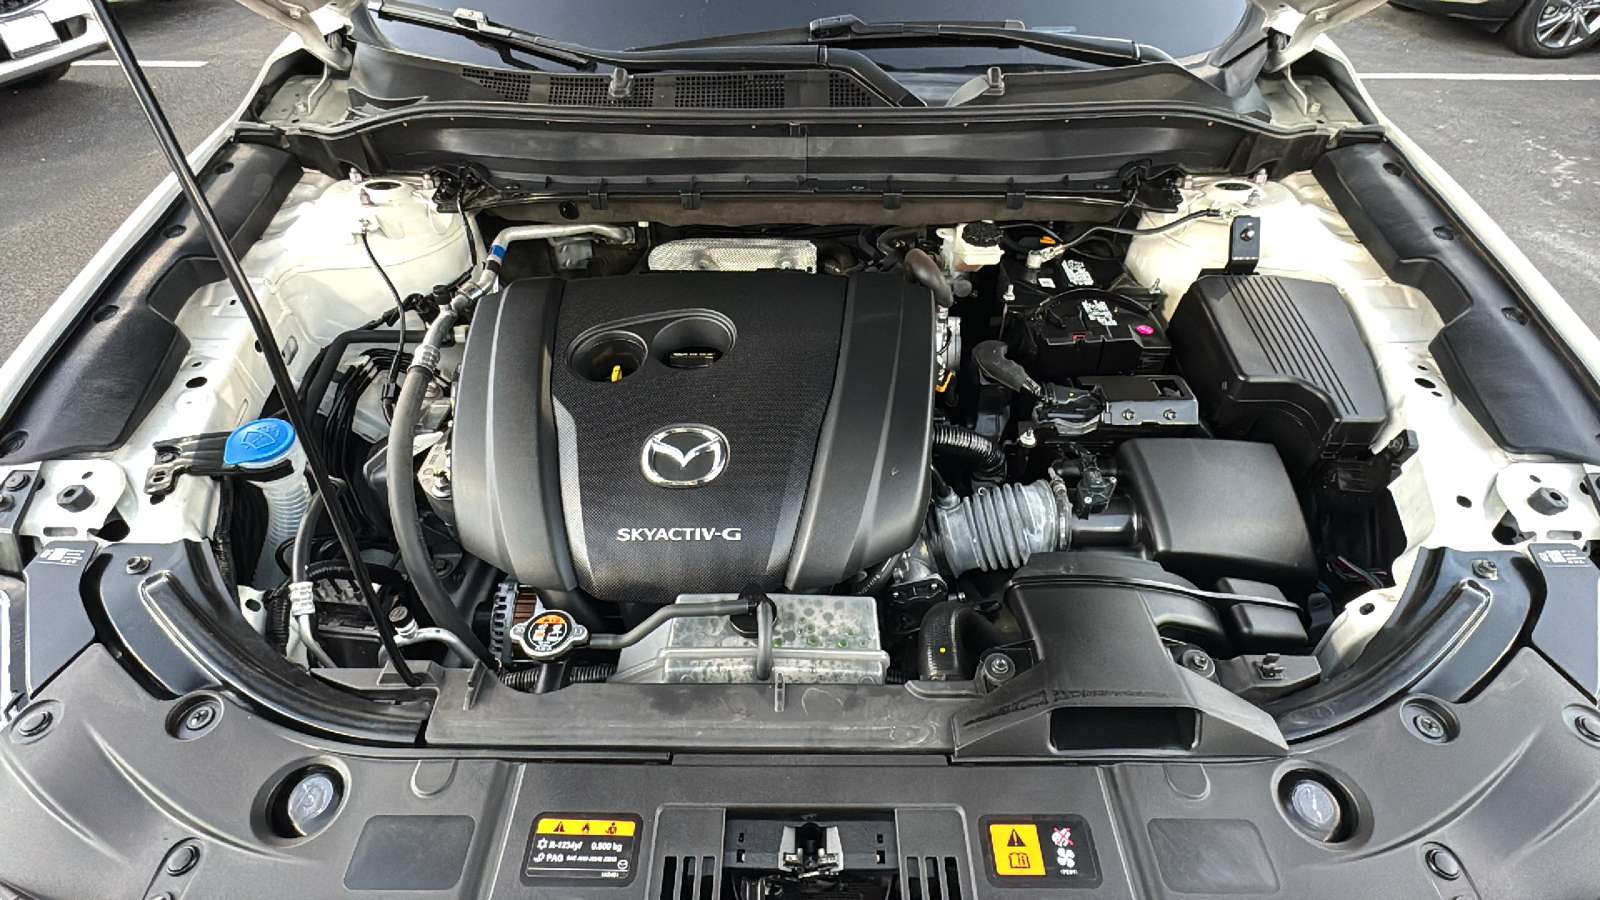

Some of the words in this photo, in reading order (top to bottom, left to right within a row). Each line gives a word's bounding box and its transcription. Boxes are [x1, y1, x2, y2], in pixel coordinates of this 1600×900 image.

[616, 527, 742, 541] SKYACTIV-G
[612, 842, 623, 853] kg
[546, 853, 564, 863] PAG
